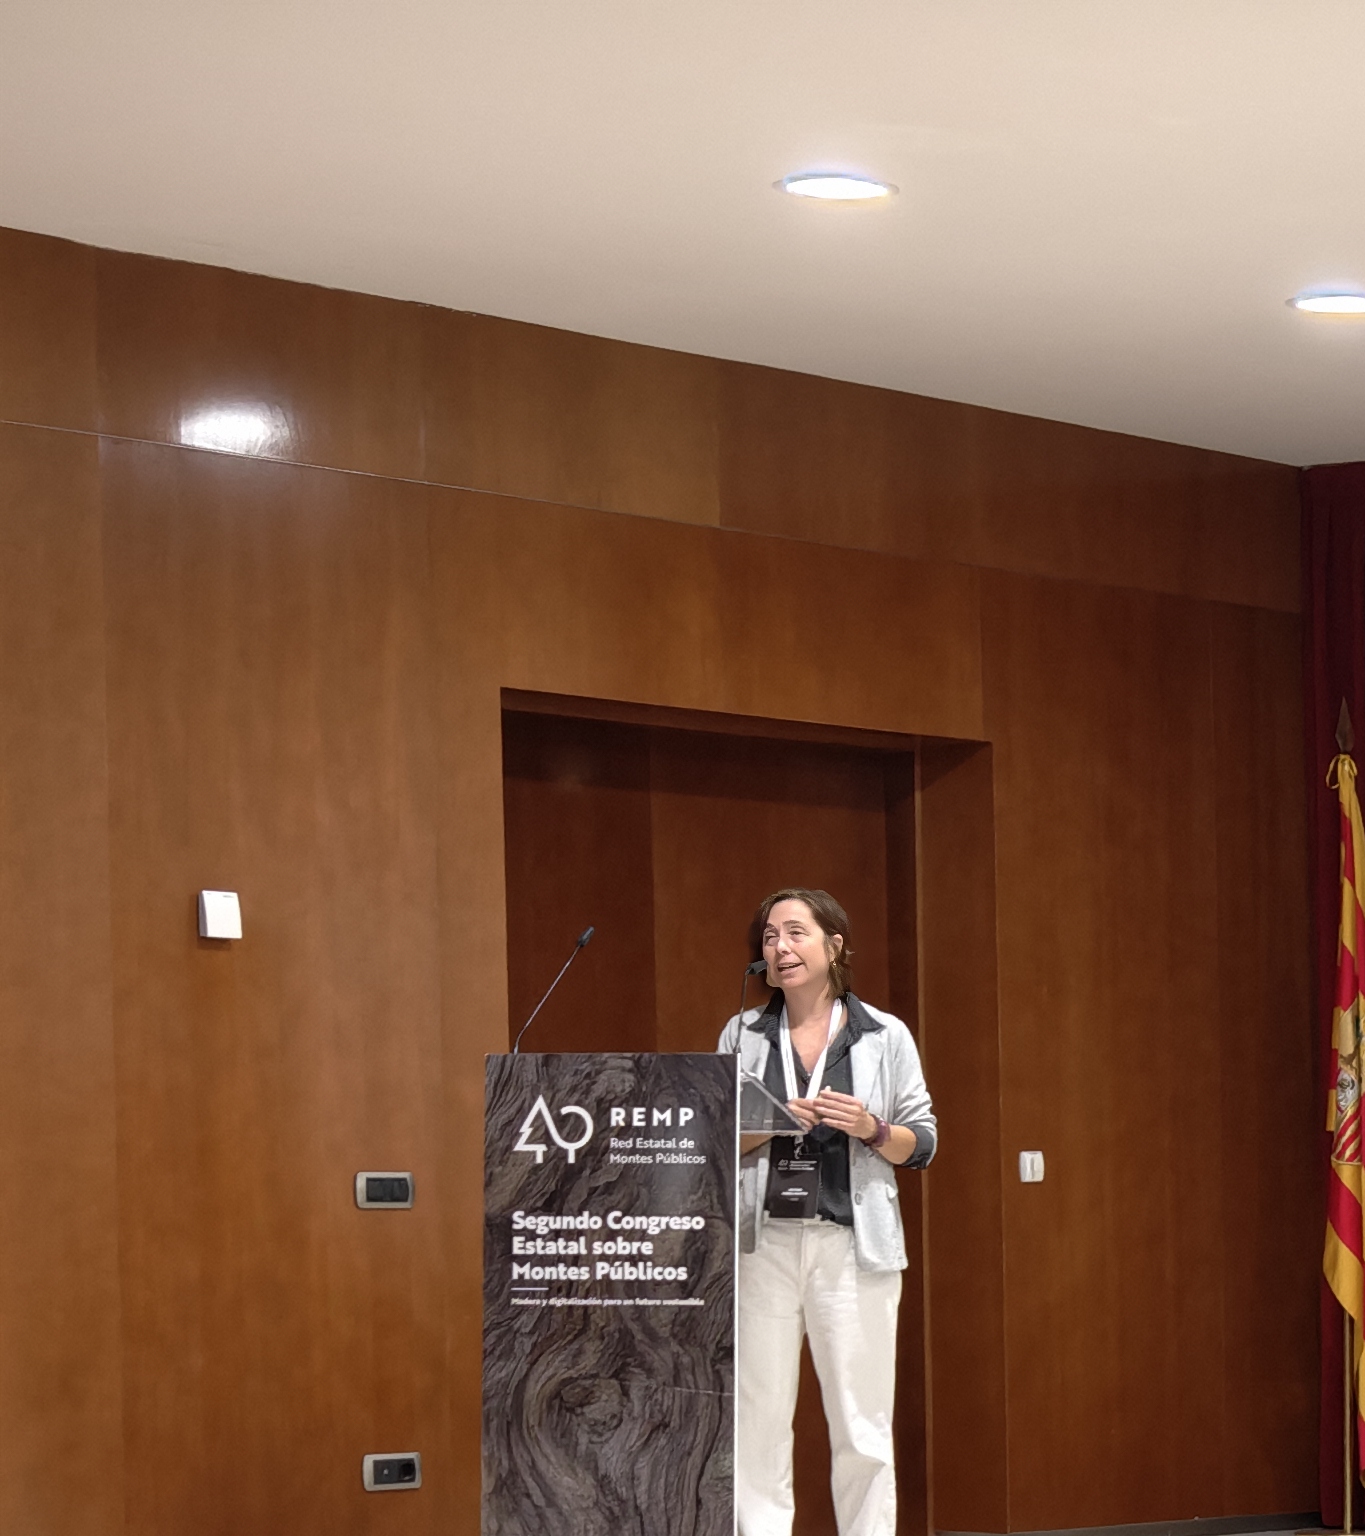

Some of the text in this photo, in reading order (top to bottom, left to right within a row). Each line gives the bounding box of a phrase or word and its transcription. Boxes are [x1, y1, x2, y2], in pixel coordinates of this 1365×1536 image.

[610, 1107, 695, 1127] REMP
[610, 1137, 695, 1149] Red Estatal de
[610, 1152, 707, 1165] Montes Públicos
[511, 1210, 706, 1235] Segundo Congreso
[511, 1236, 654, 1255] Estatal sobre
[511, 1260, 688, 1281] Montes Públicos
